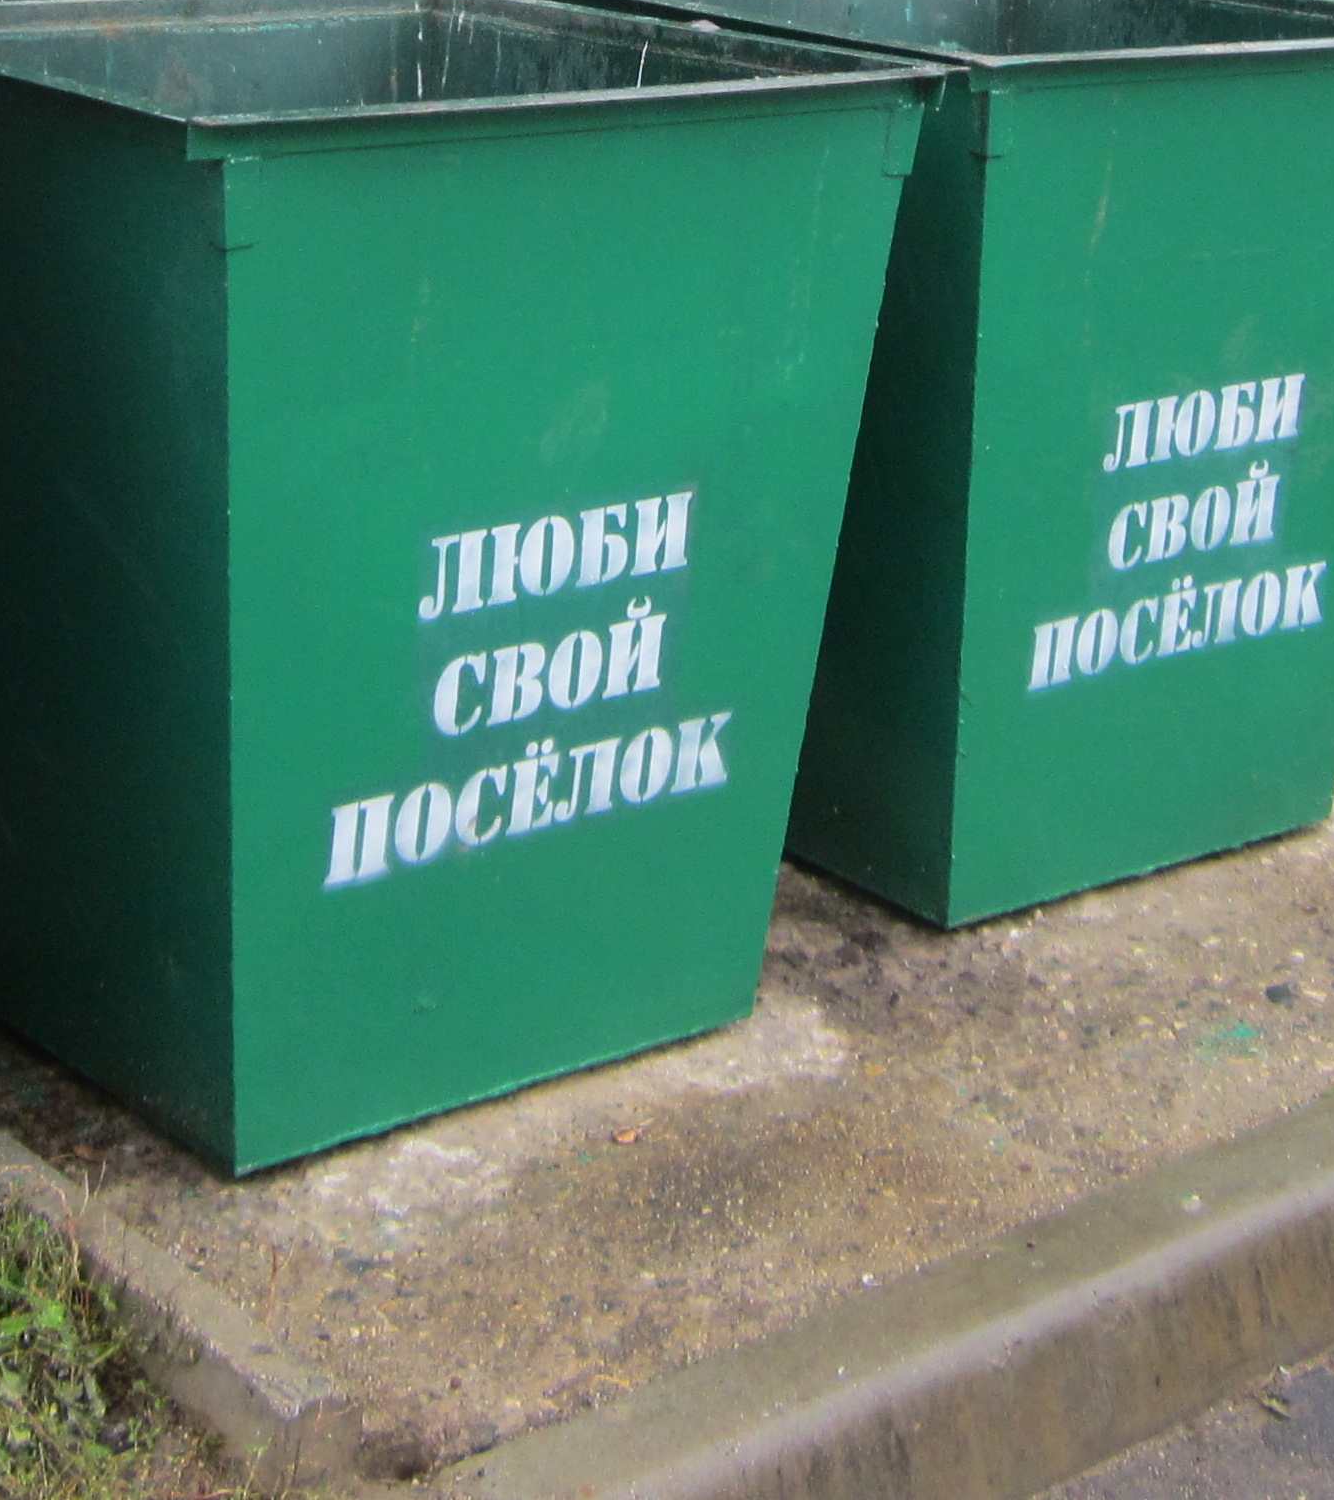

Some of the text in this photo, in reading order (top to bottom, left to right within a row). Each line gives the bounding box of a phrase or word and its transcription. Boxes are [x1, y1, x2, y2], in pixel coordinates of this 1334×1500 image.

[1102, 373, 1306, 472] ЛЮБИ
[418, 490, 694, 619] ЛЮБИ
[1107, 459, 1282, 570] СВОЙ
[433, 595, 667, 736] СВОЙ
[1028, 561, 1328, 690] ПОСЁЛОК
[324, 711, 732, 886] ПОСЁЛОК
